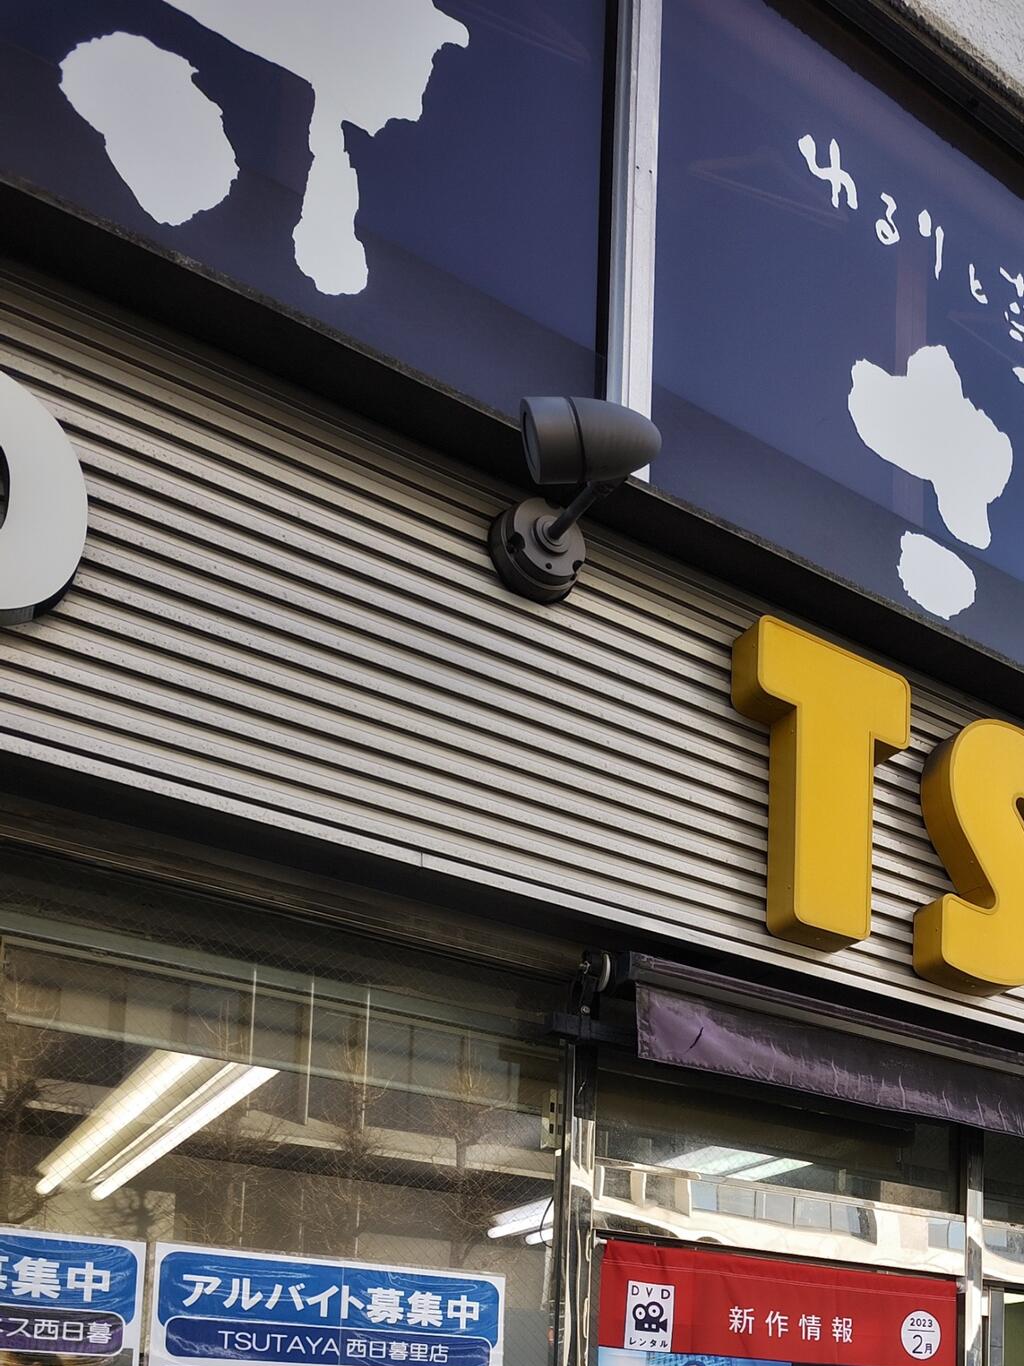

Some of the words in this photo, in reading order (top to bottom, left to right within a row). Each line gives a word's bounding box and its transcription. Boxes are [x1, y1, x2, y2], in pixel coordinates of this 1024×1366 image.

[182, 1274, 480, 1330] アルバイト募集中
[631, 1283, 671, 1300] DVD
[0, 1318, 112, 1345] ス西日暮
[728, 1305, 854, 1344] 新作情報
[909, 1316, 934, 1328] 2023
[218, 1330, 341, 1356] TSUTAYA
[346, 1339, 450, 1363] 西日暮里店
[628, 1337, 669, 1349] レンタル
[912, 1334, 934, 1355] 2月
